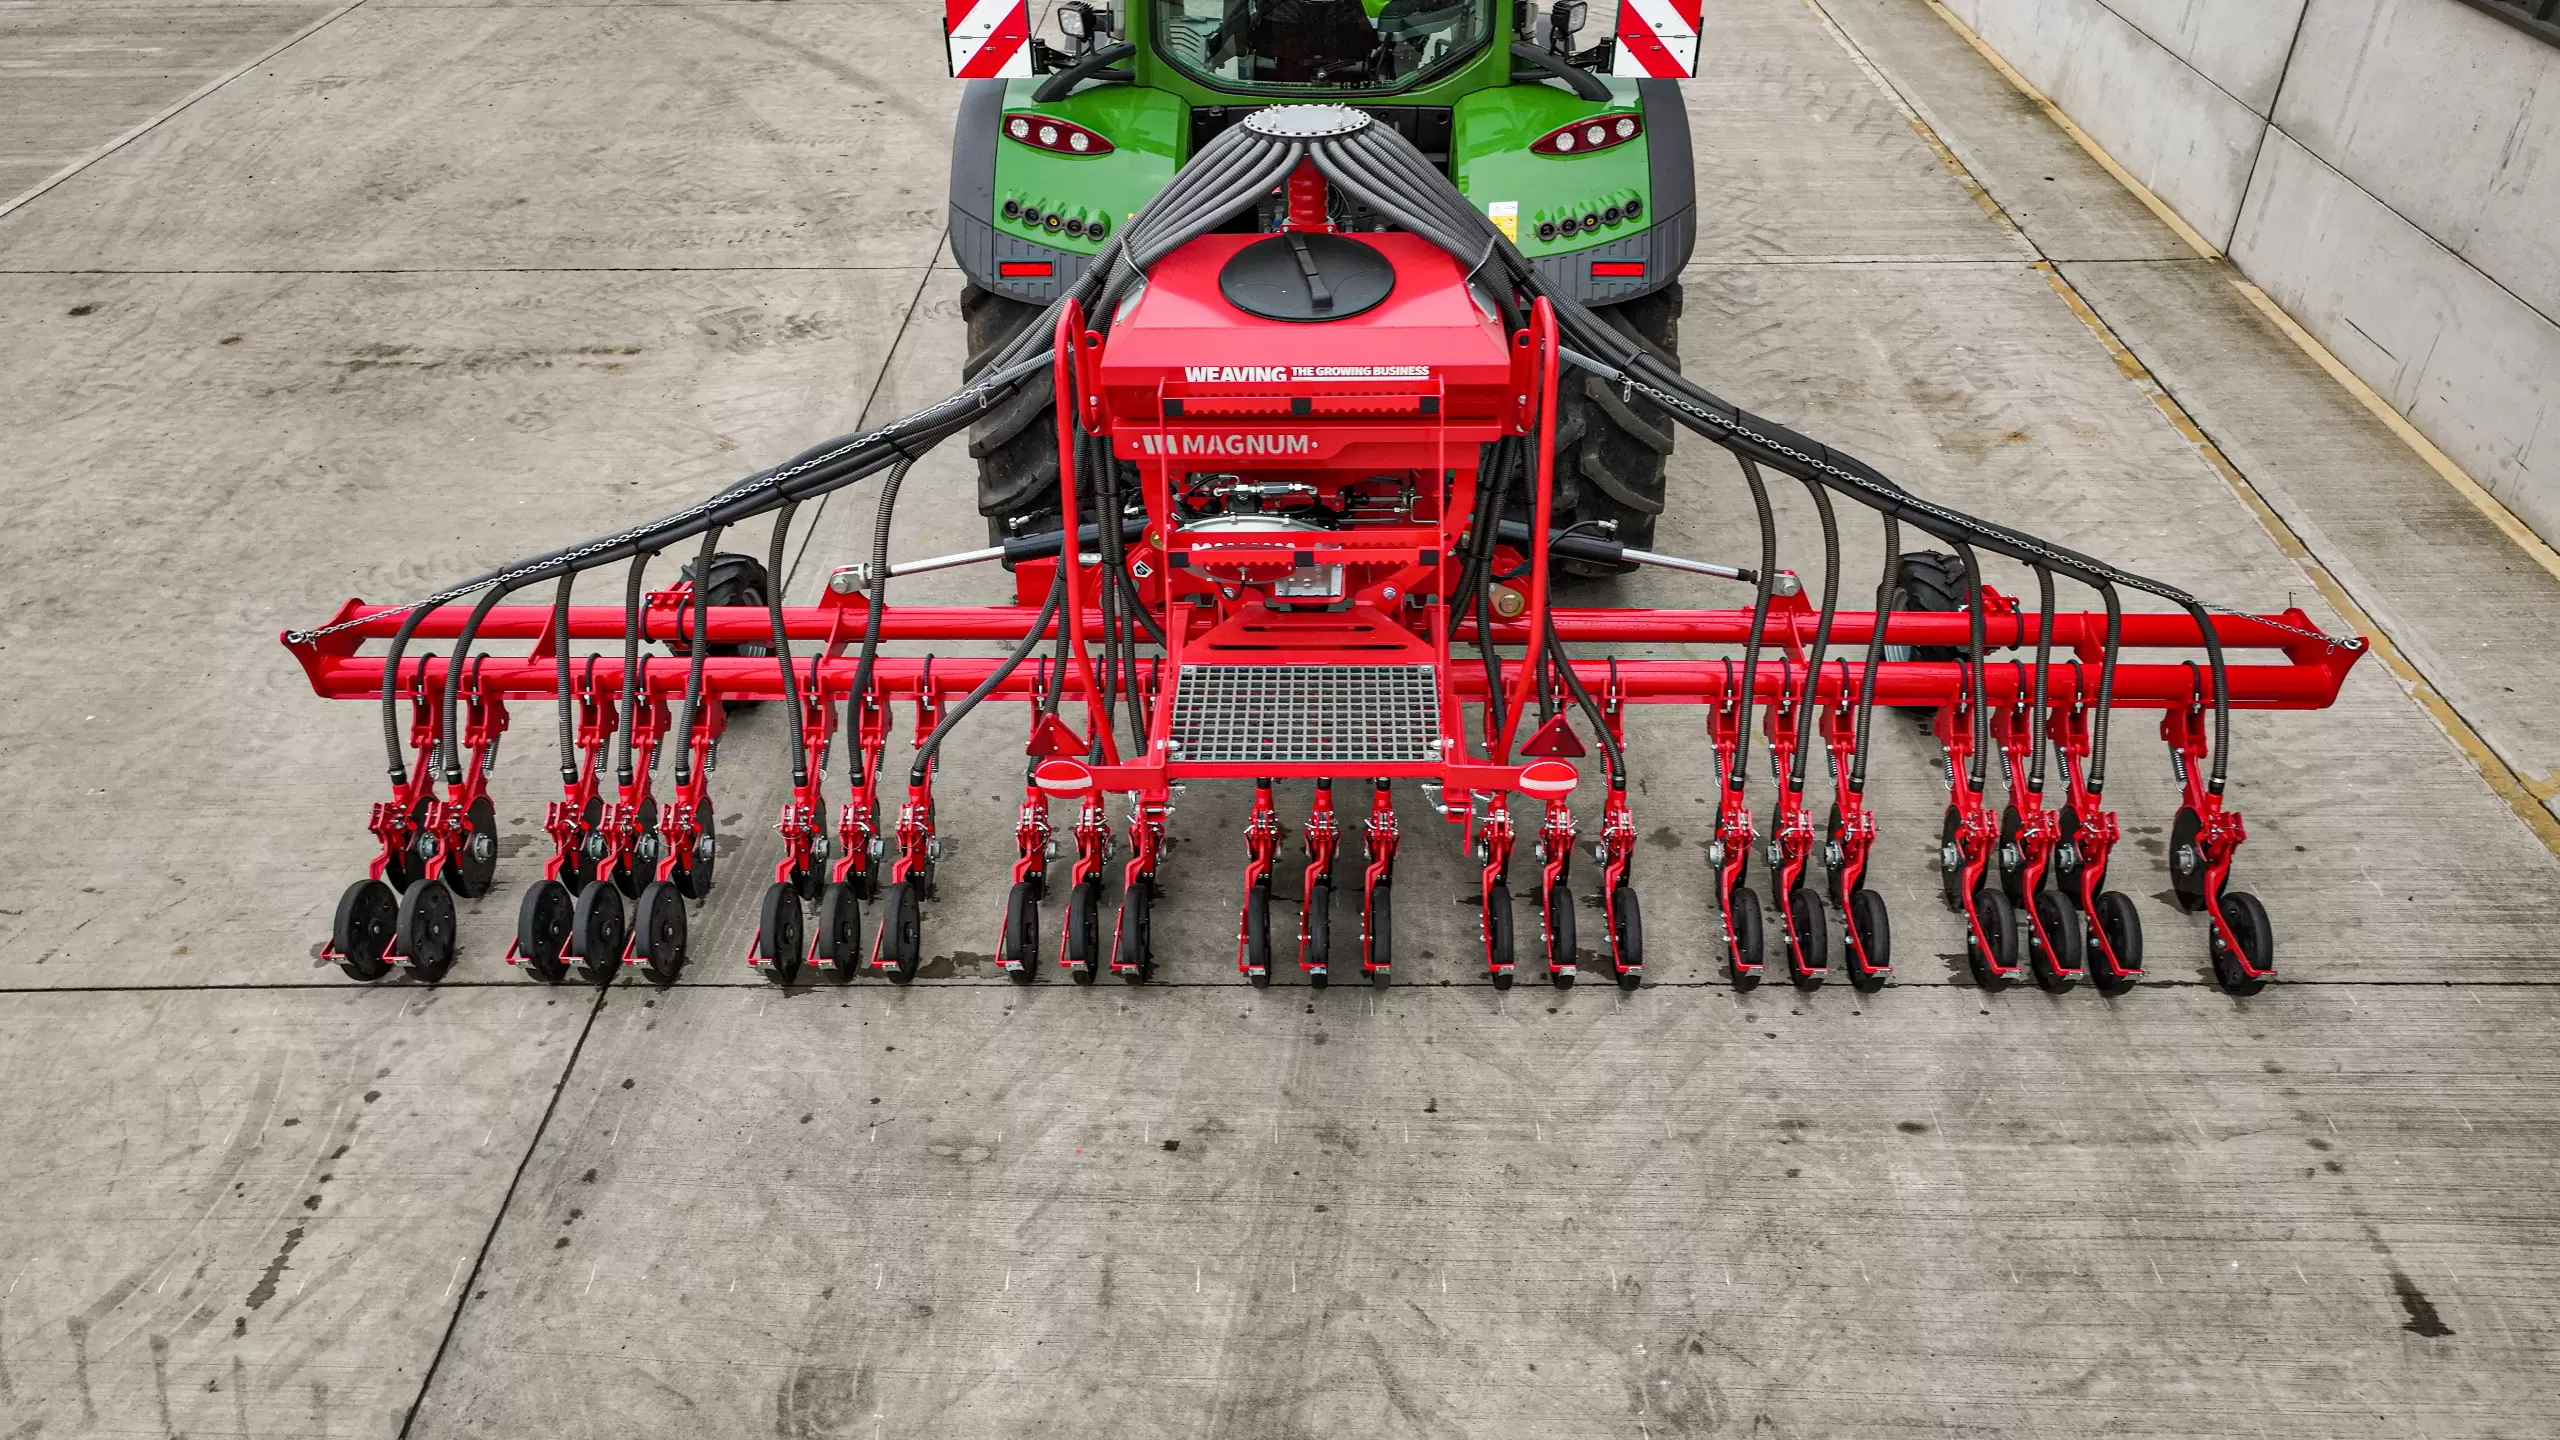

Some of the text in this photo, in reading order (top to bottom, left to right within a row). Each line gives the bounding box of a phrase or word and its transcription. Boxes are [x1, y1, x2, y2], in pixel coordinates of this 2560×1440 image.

[1184, 365, 1430, 382] WEAVING THE GROWING BUSINESS
[1182, 434, 1309, 454] MAGNUM
